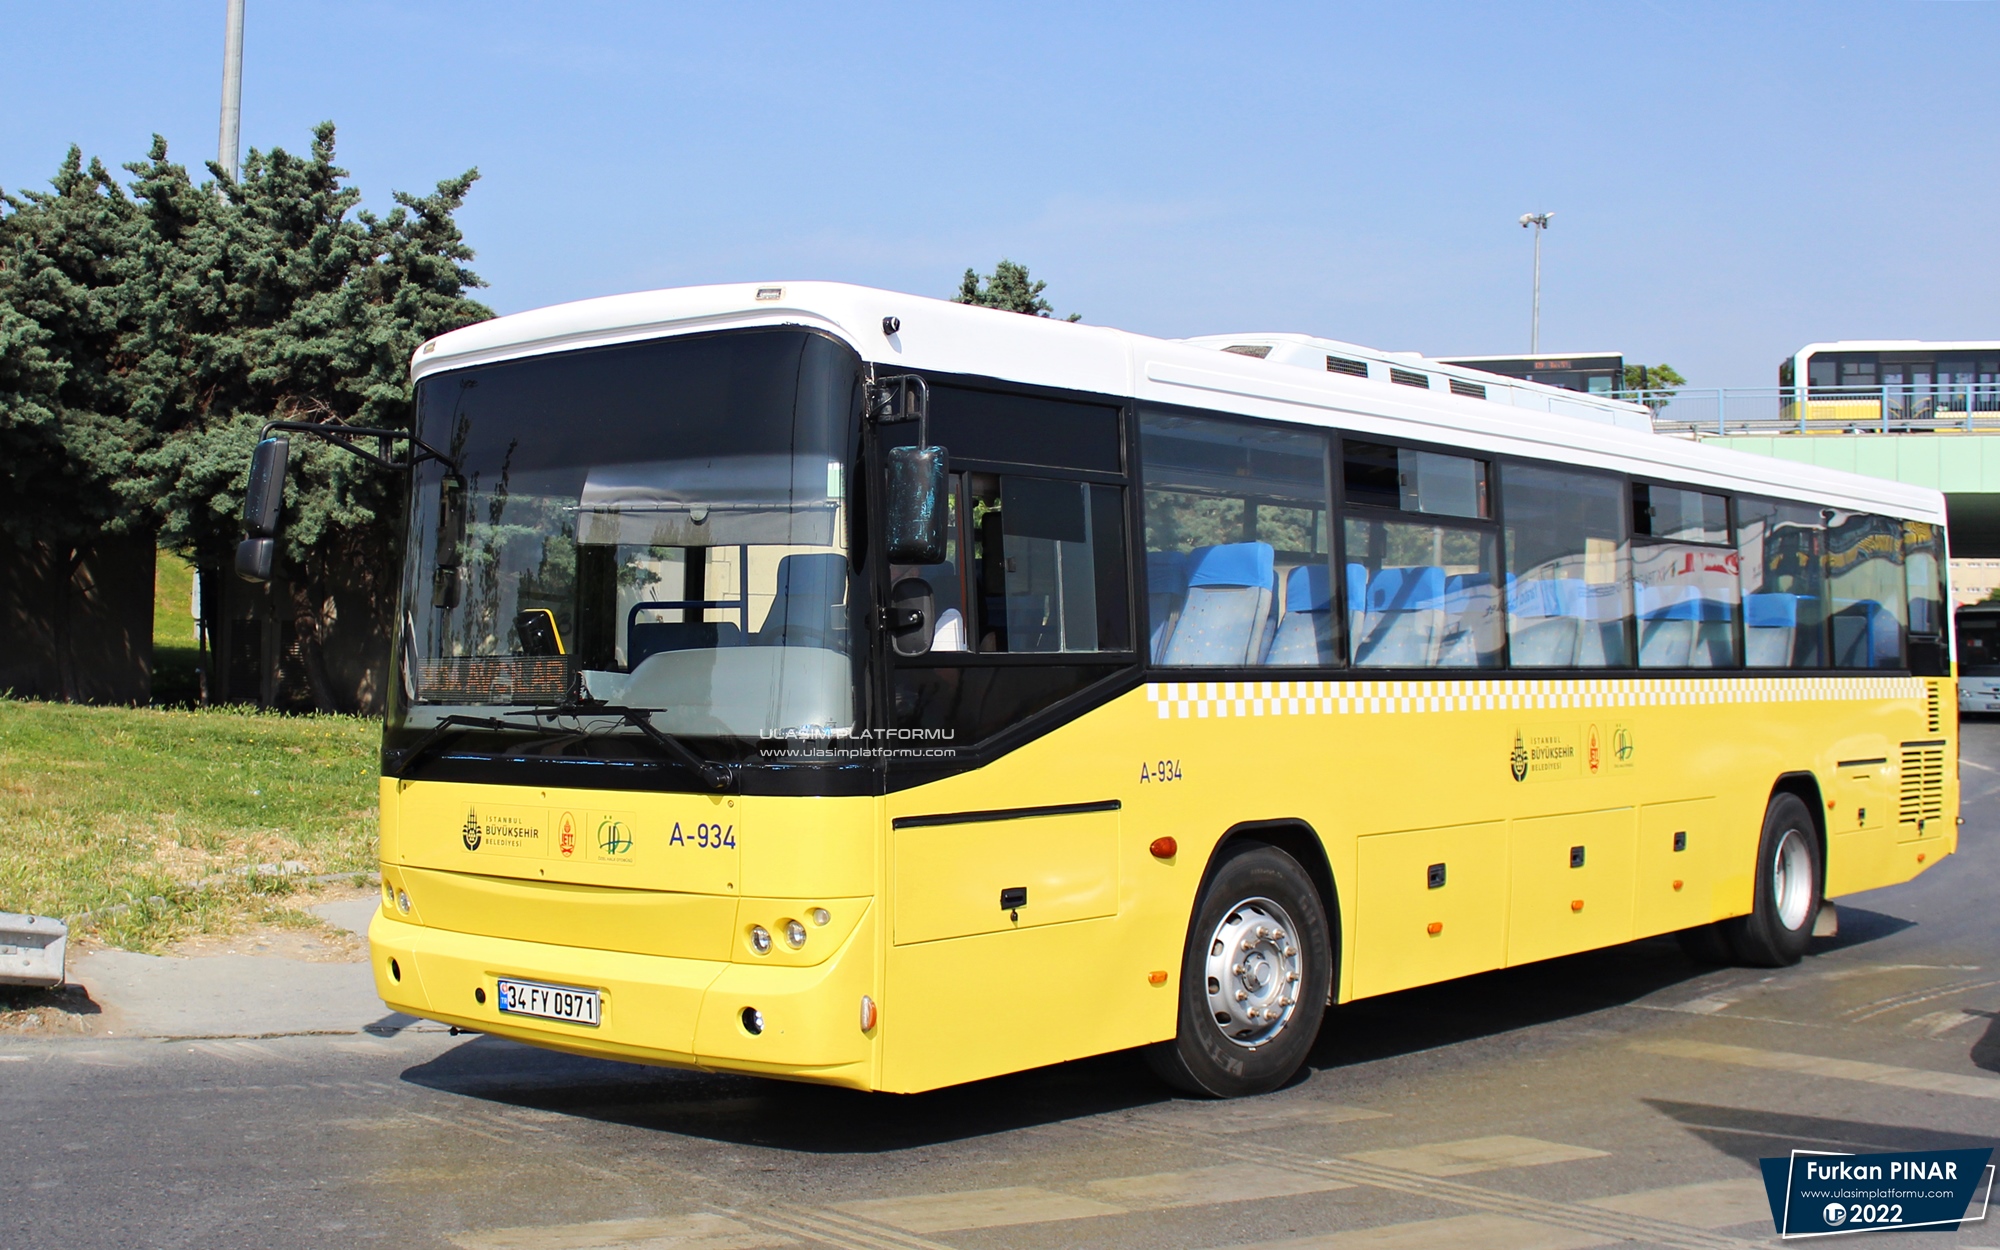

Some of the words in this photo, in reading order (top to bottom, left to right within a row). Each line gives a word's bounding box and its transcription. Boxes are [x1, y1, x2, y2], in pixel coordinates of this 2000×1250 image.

[466, 660, 565, 694] AVCILAR
[1531, 745, 1574, 760] BÜYÜKŞEHİR
[1140, 759, 1182, 784] A-934
[485, 814, 522, 825] İSTANBUL
[485, 824, 539, 839] BÜYÜKŞEHİR
[669, 822, 736, 850] A-934
[508, 985, 526, 1009] 34
[531, 988, 549, 1012] FY
[554, 992, 593, 1019] 0971
